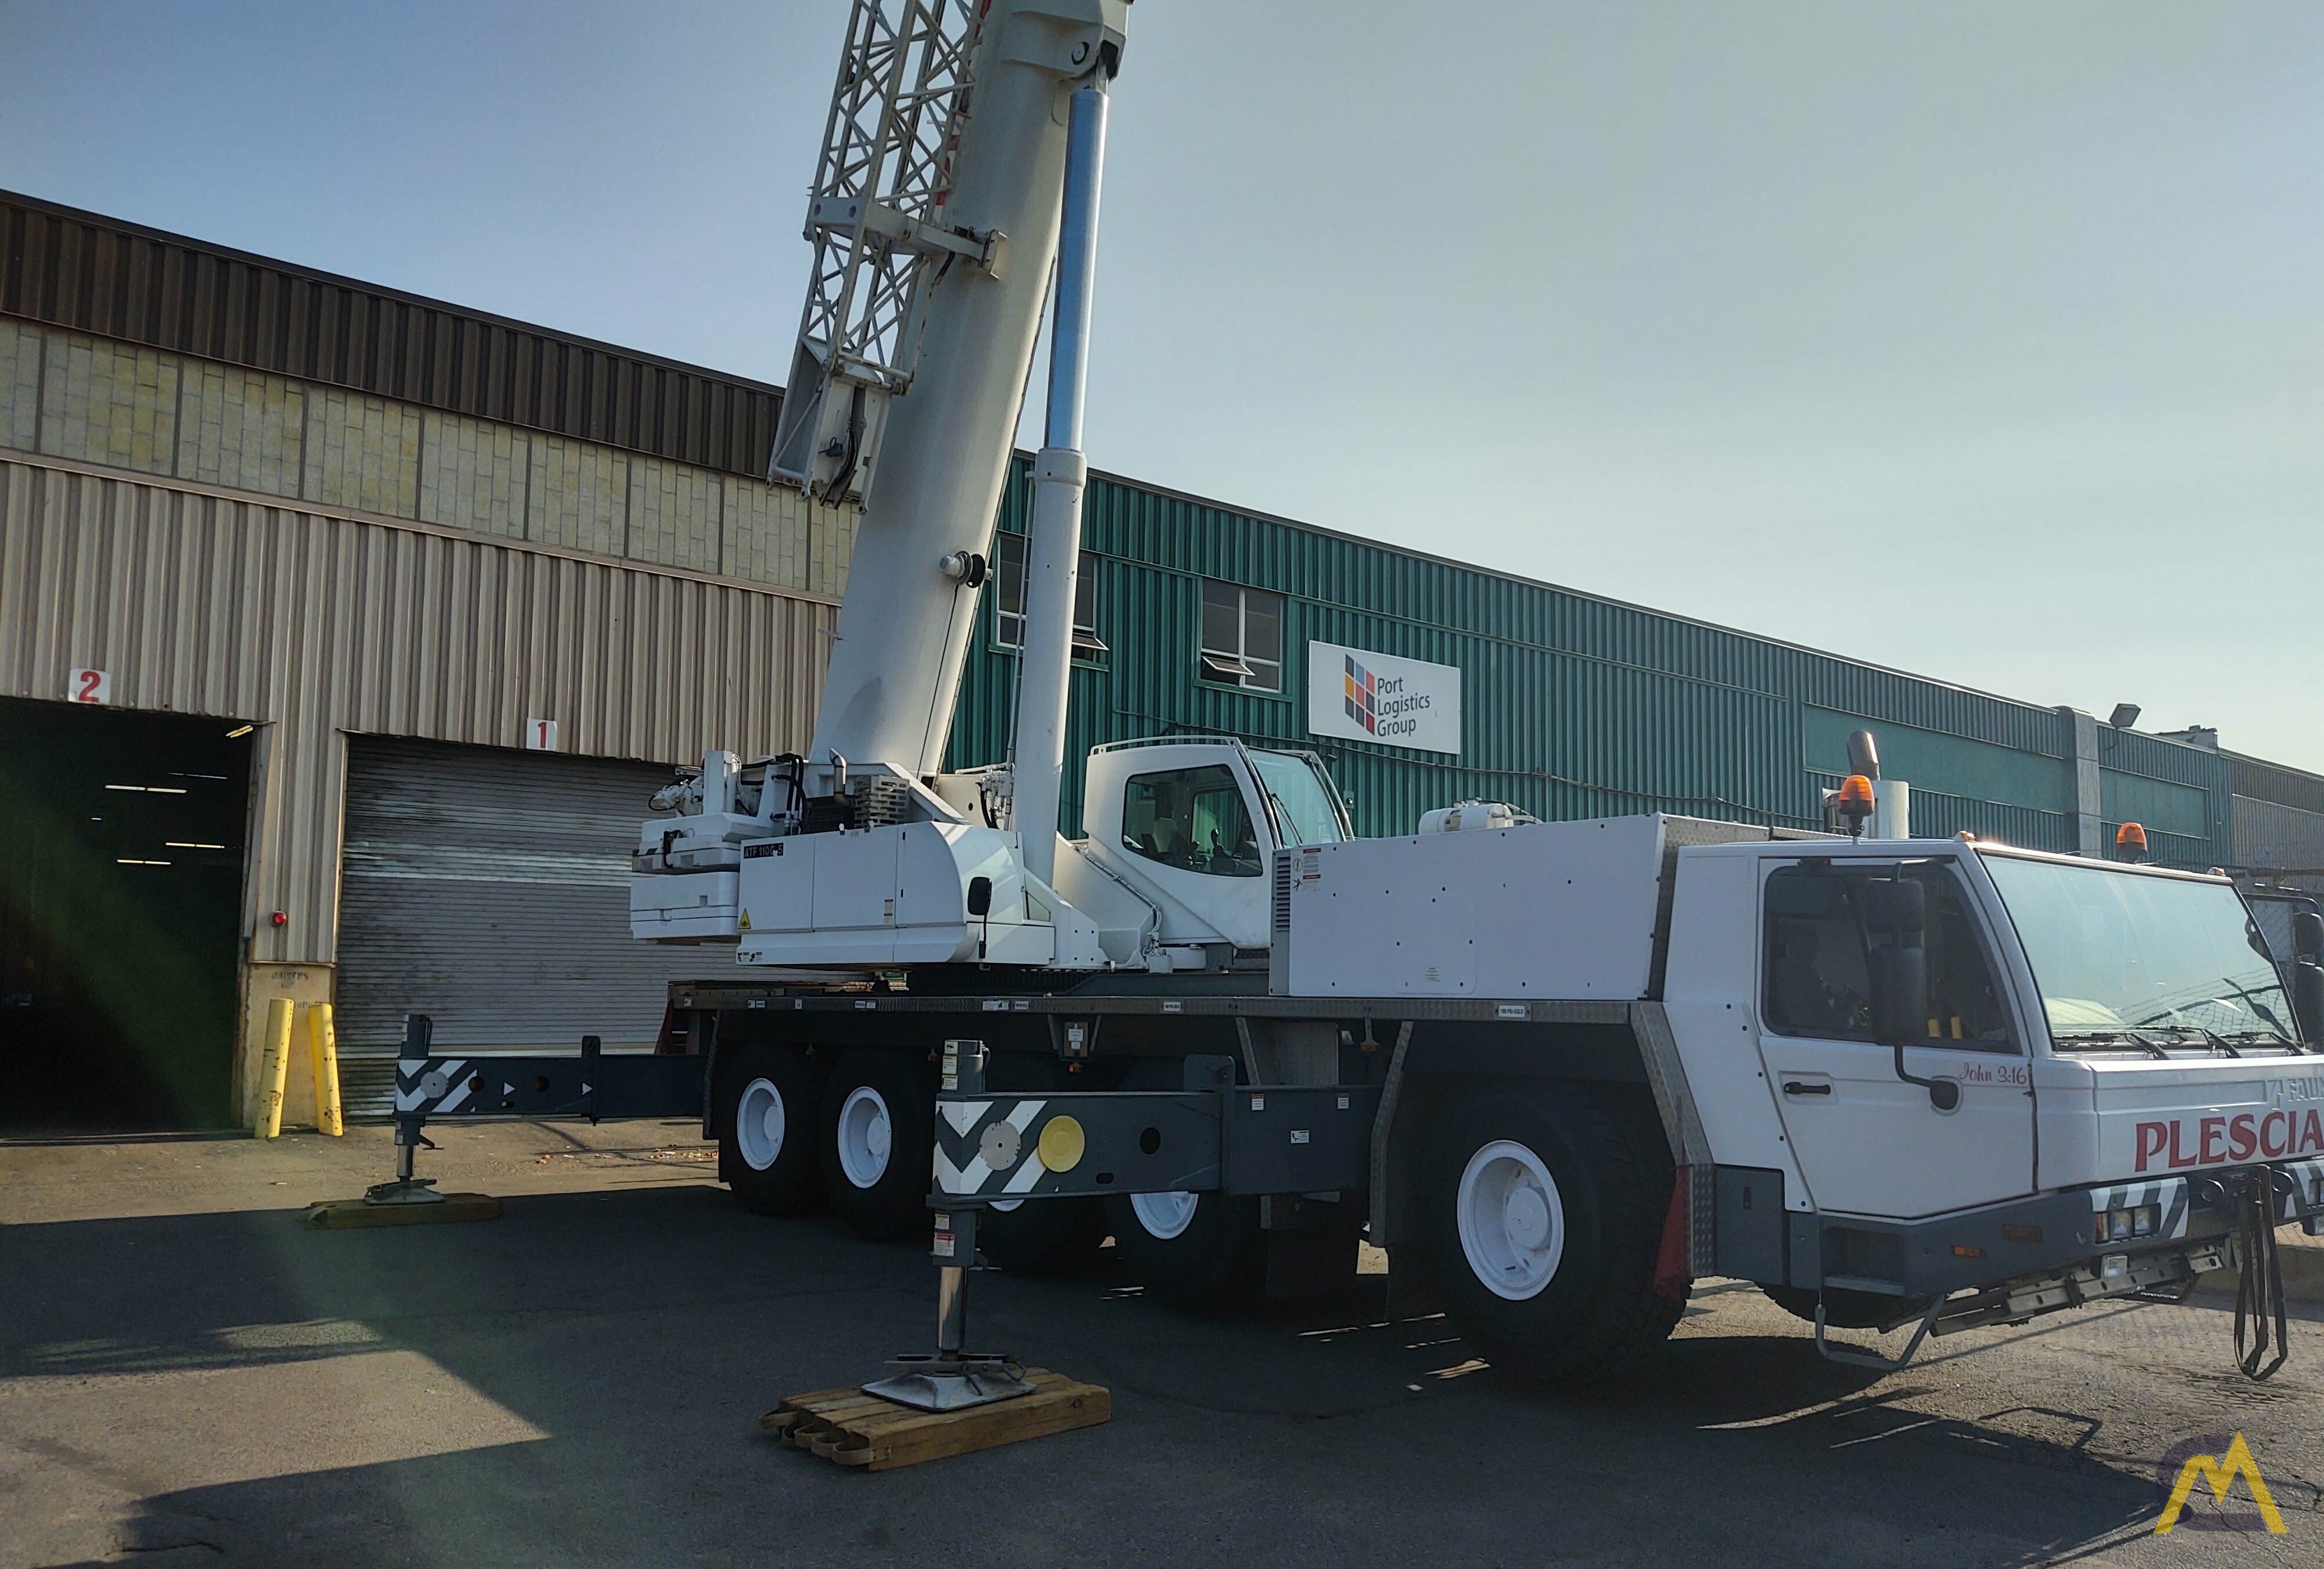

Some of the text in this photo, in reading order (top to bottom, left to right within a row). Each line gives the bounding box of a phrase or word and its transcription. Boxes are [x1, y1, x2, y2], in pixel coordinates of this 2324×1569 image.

[78, 671, 101, 703] 2
[1378, 676, 1403, 696] Port
[1378, 692, 1430, 718] Logistics
[538, 722, 547, 748] 1
[1377, 719, 1416, 737] Group
[745, 847, 758, 858] ATF
[1959, 1062, 2027, 1084] John 3:16
[2135, 1109, 2324, 1173] PLESCIA
